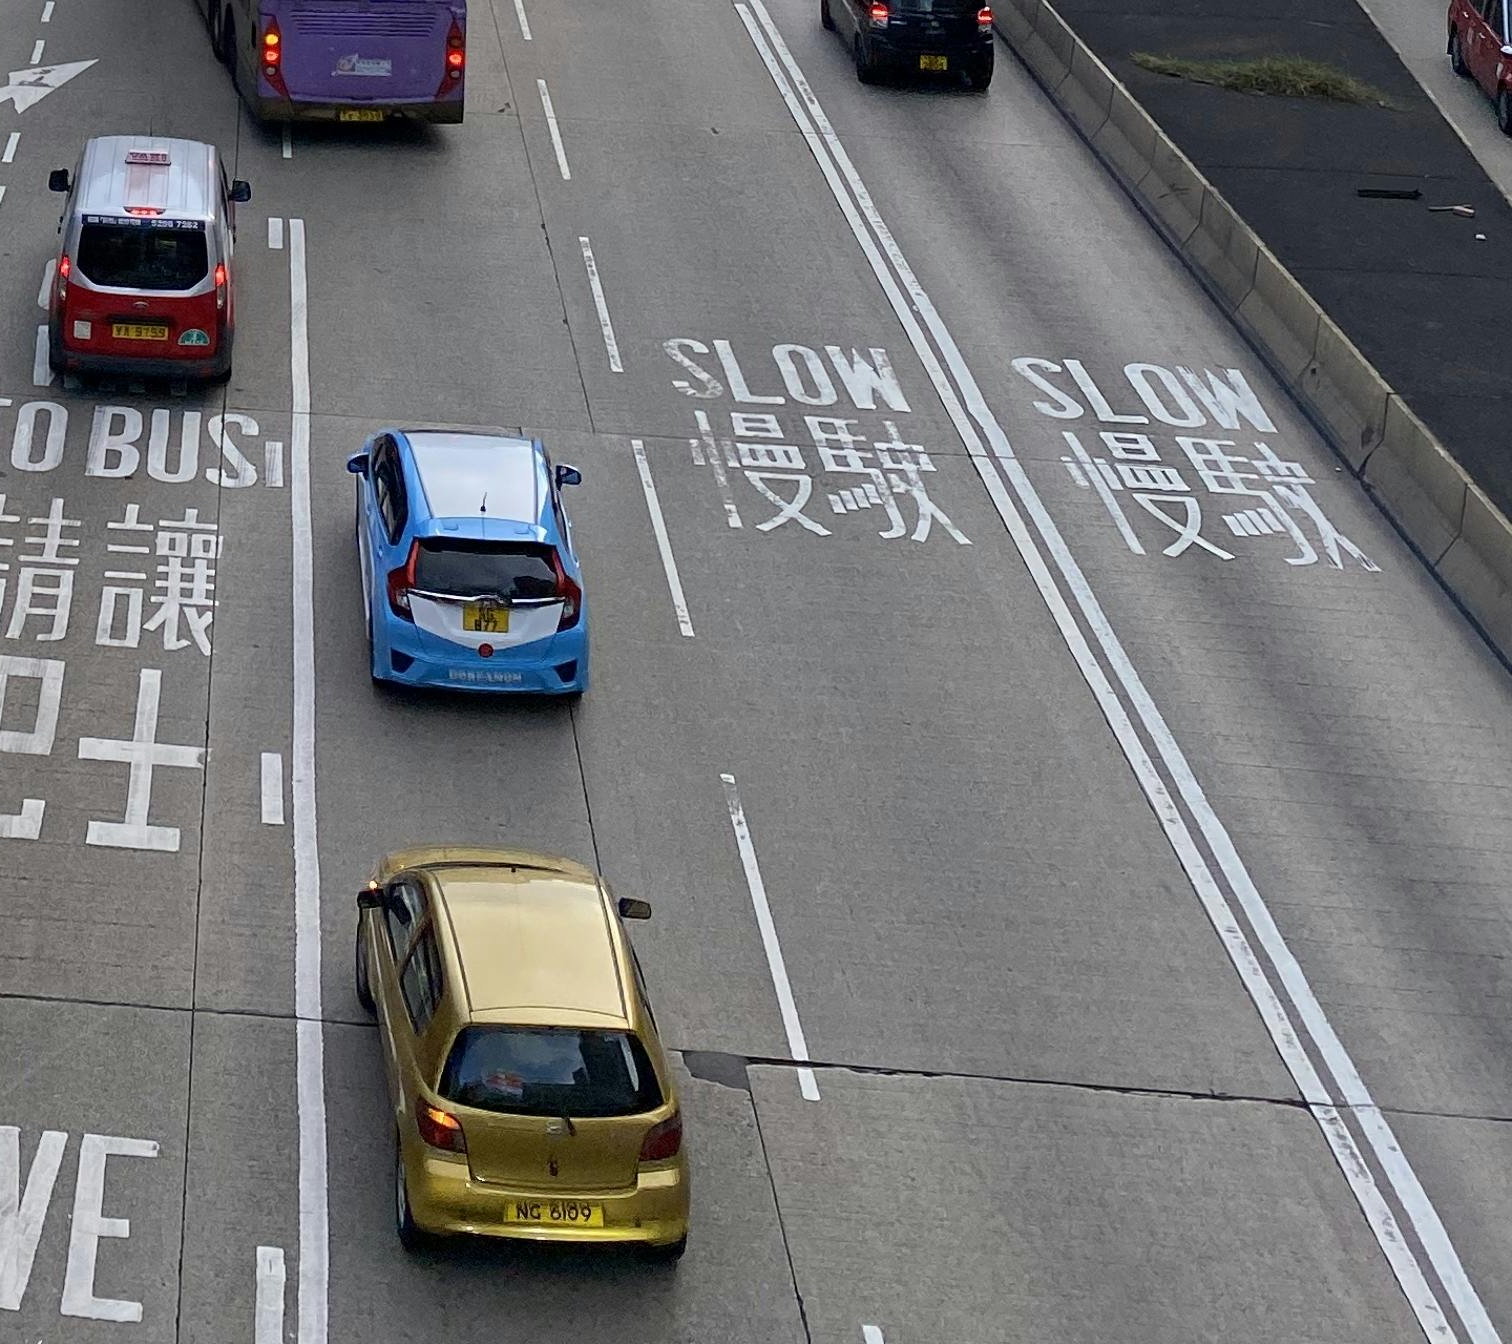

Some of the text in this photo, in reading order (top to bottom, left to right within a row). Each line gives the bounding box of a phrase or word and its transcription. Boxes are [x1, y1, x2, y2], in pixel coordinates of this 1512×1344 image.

[663, 337, 912, 413] SLOW
[1010, 356, 1278, 433] SLOW
[85, 405, 260, 489] BUS
[688, 409, 973, 546] 慢駛
[1060, 430, 1382, 573] 慢駛
